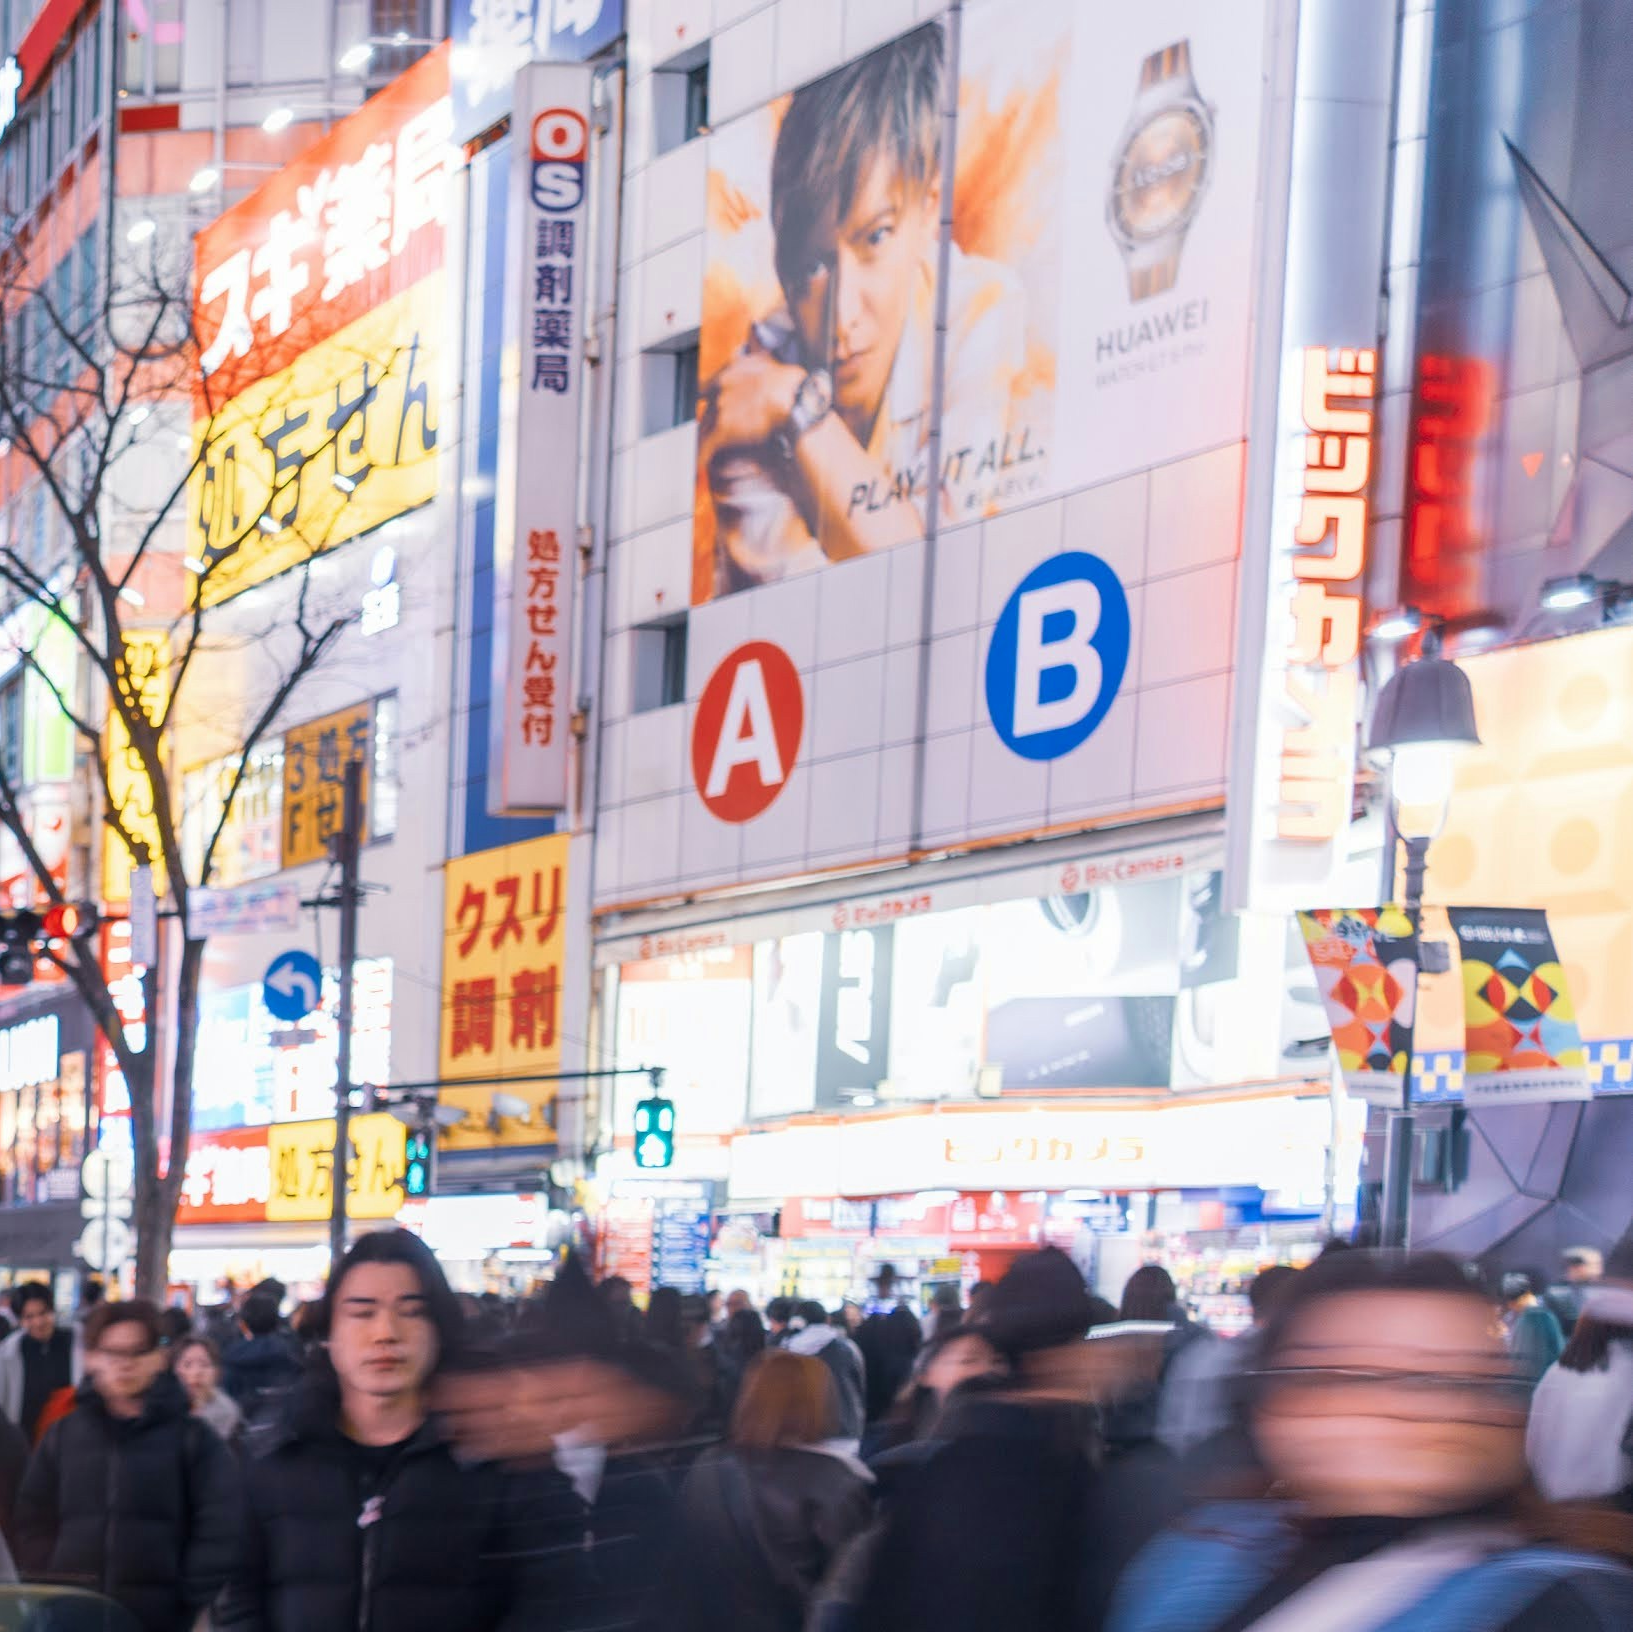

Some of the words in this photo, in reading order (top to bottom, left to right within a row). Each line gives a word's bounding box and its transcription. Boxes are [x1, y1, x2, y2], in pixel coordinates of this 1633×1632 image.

[532, 110, 587, 212] OS
[534, 219, 575, 395] 調剤薬局
[1095, 298, 1209, 363] HUAWEI
[848, 460, 926, 519] PLAY
[941, 446, 973, 484] IT
[975, 424, 1045, 477] ALL.
[521, 530, 560, 746] 処方せん受付
[1012, 578, 1103, 738] B
[705, 657, 784, 799] A
[455, 866, 562, 960] クスリ
[1084, 855, 1184, 884] BicCamera
[451, 965, 557, 1059] 調剤
